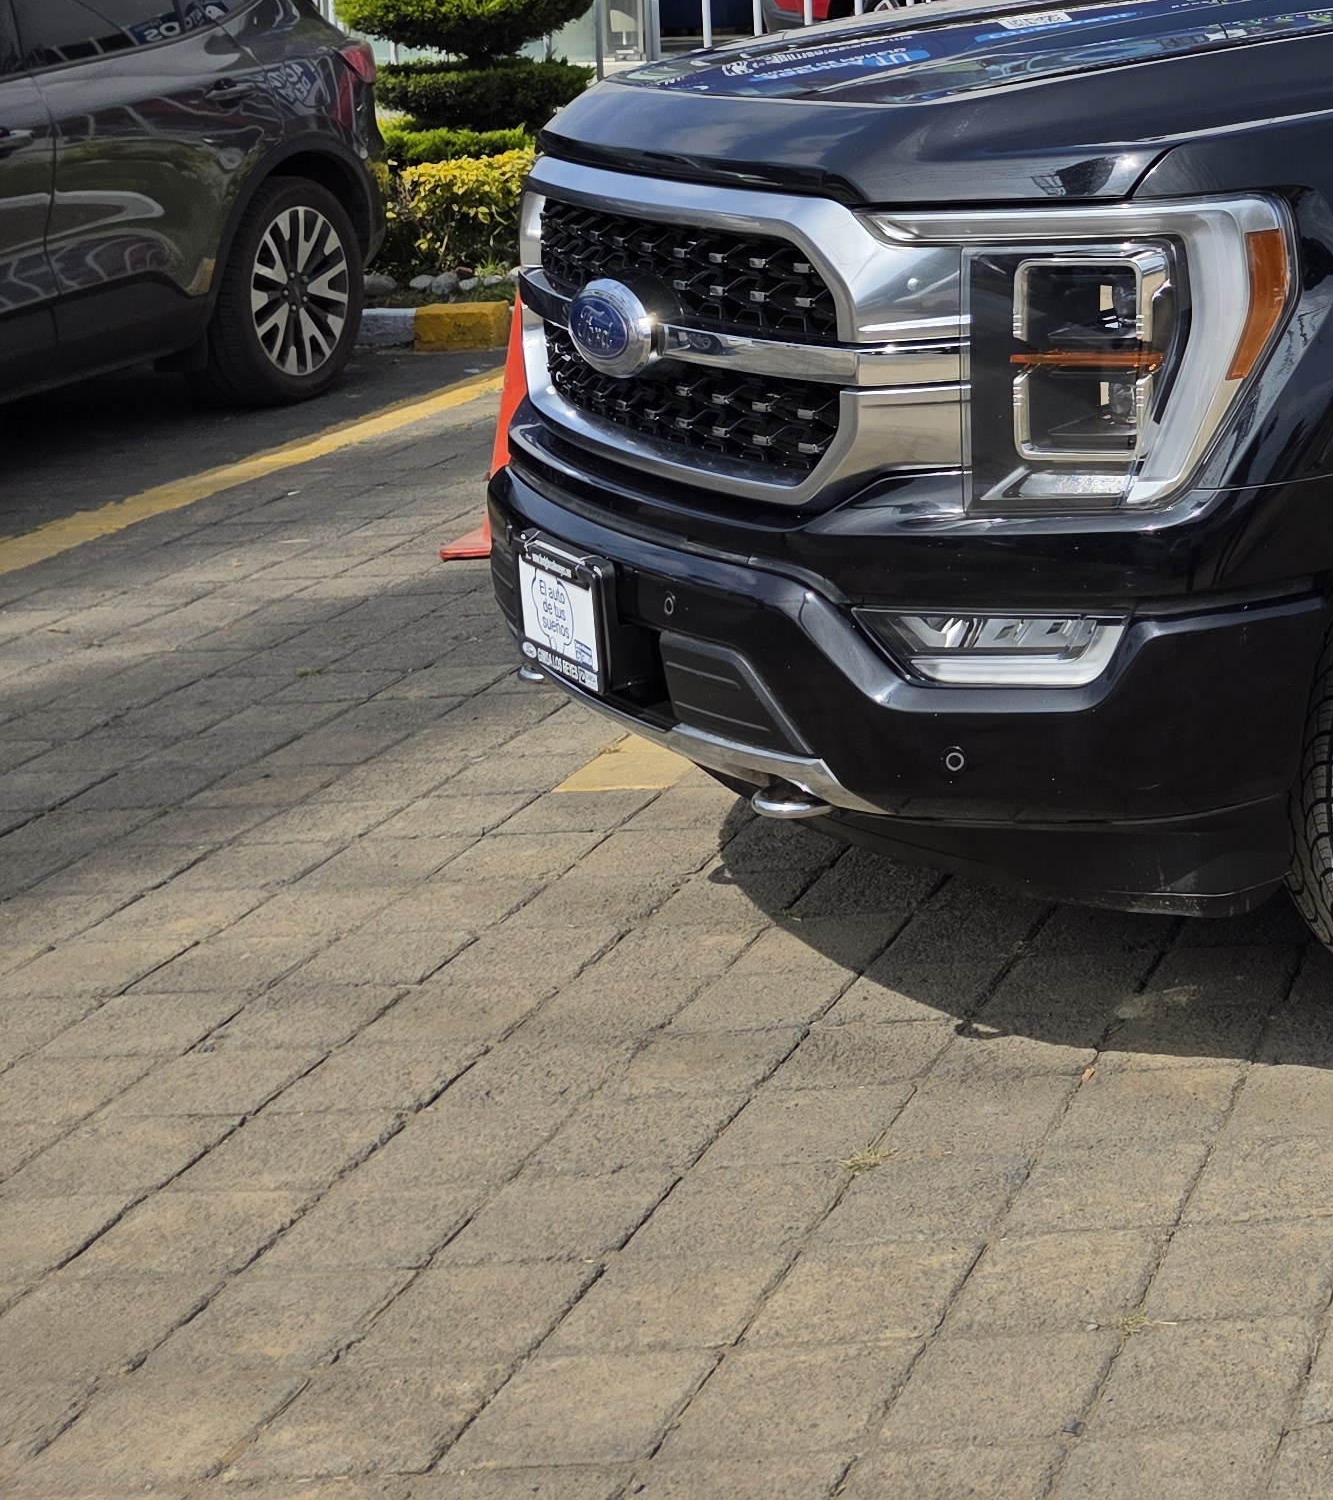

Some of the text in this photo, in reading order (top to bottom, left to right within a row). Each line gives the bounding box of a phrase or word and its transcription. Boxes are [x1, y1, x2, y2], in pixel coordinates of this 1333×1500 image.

[577, 306, 614, 349] Ford
[539, 579, 565, 605] El auto
[542, 599, 566, 621] de tus
[542, 616, 570, 639] sueños
